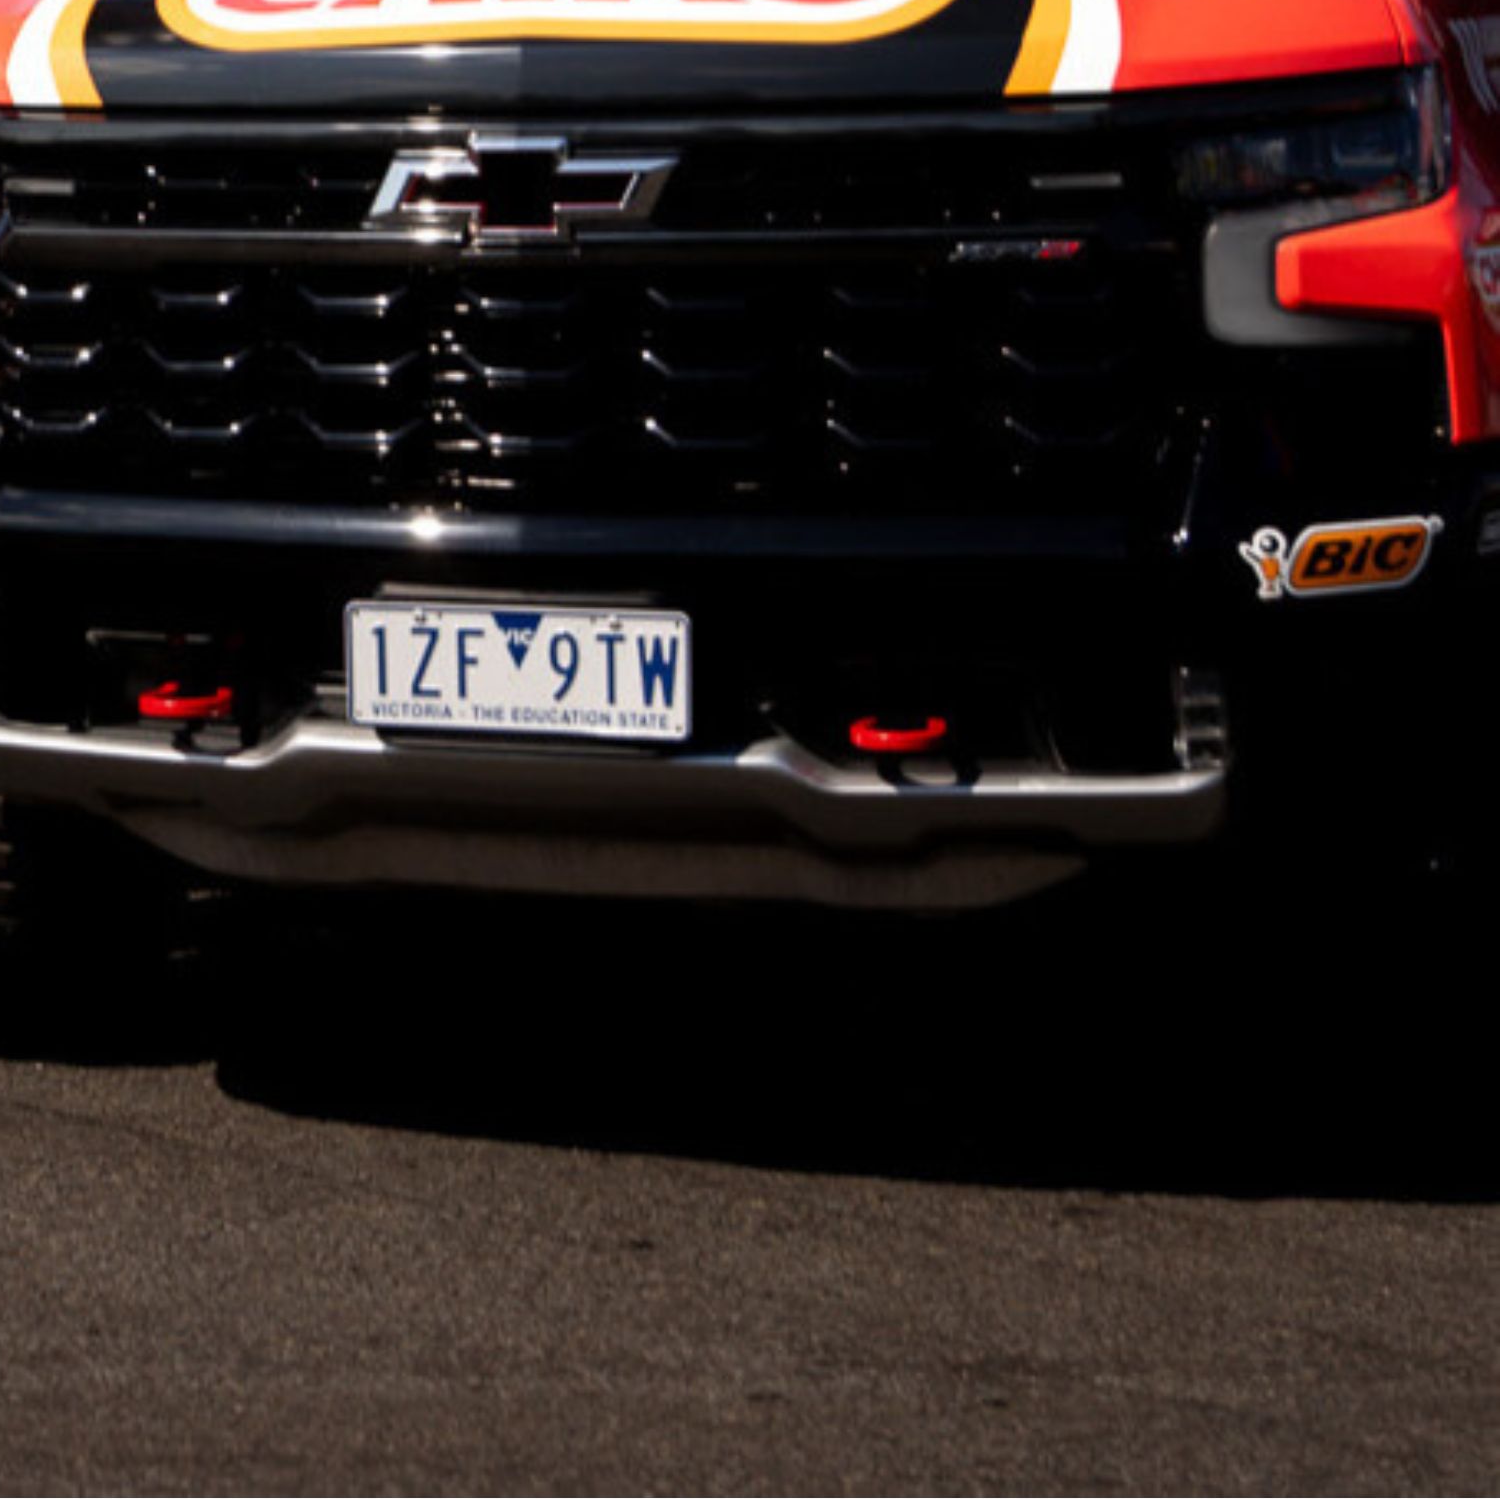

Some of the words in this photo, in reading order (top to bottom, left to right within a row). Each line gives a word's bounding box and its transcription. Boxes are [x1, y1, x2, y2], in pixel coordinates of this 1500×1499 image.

[371, 701, 453, 720] VICTORIA
[472, 705, 506, 724] THE
[510, 707, 612, 728] EDUCATION
[618, 712, 669, 731] STATE
